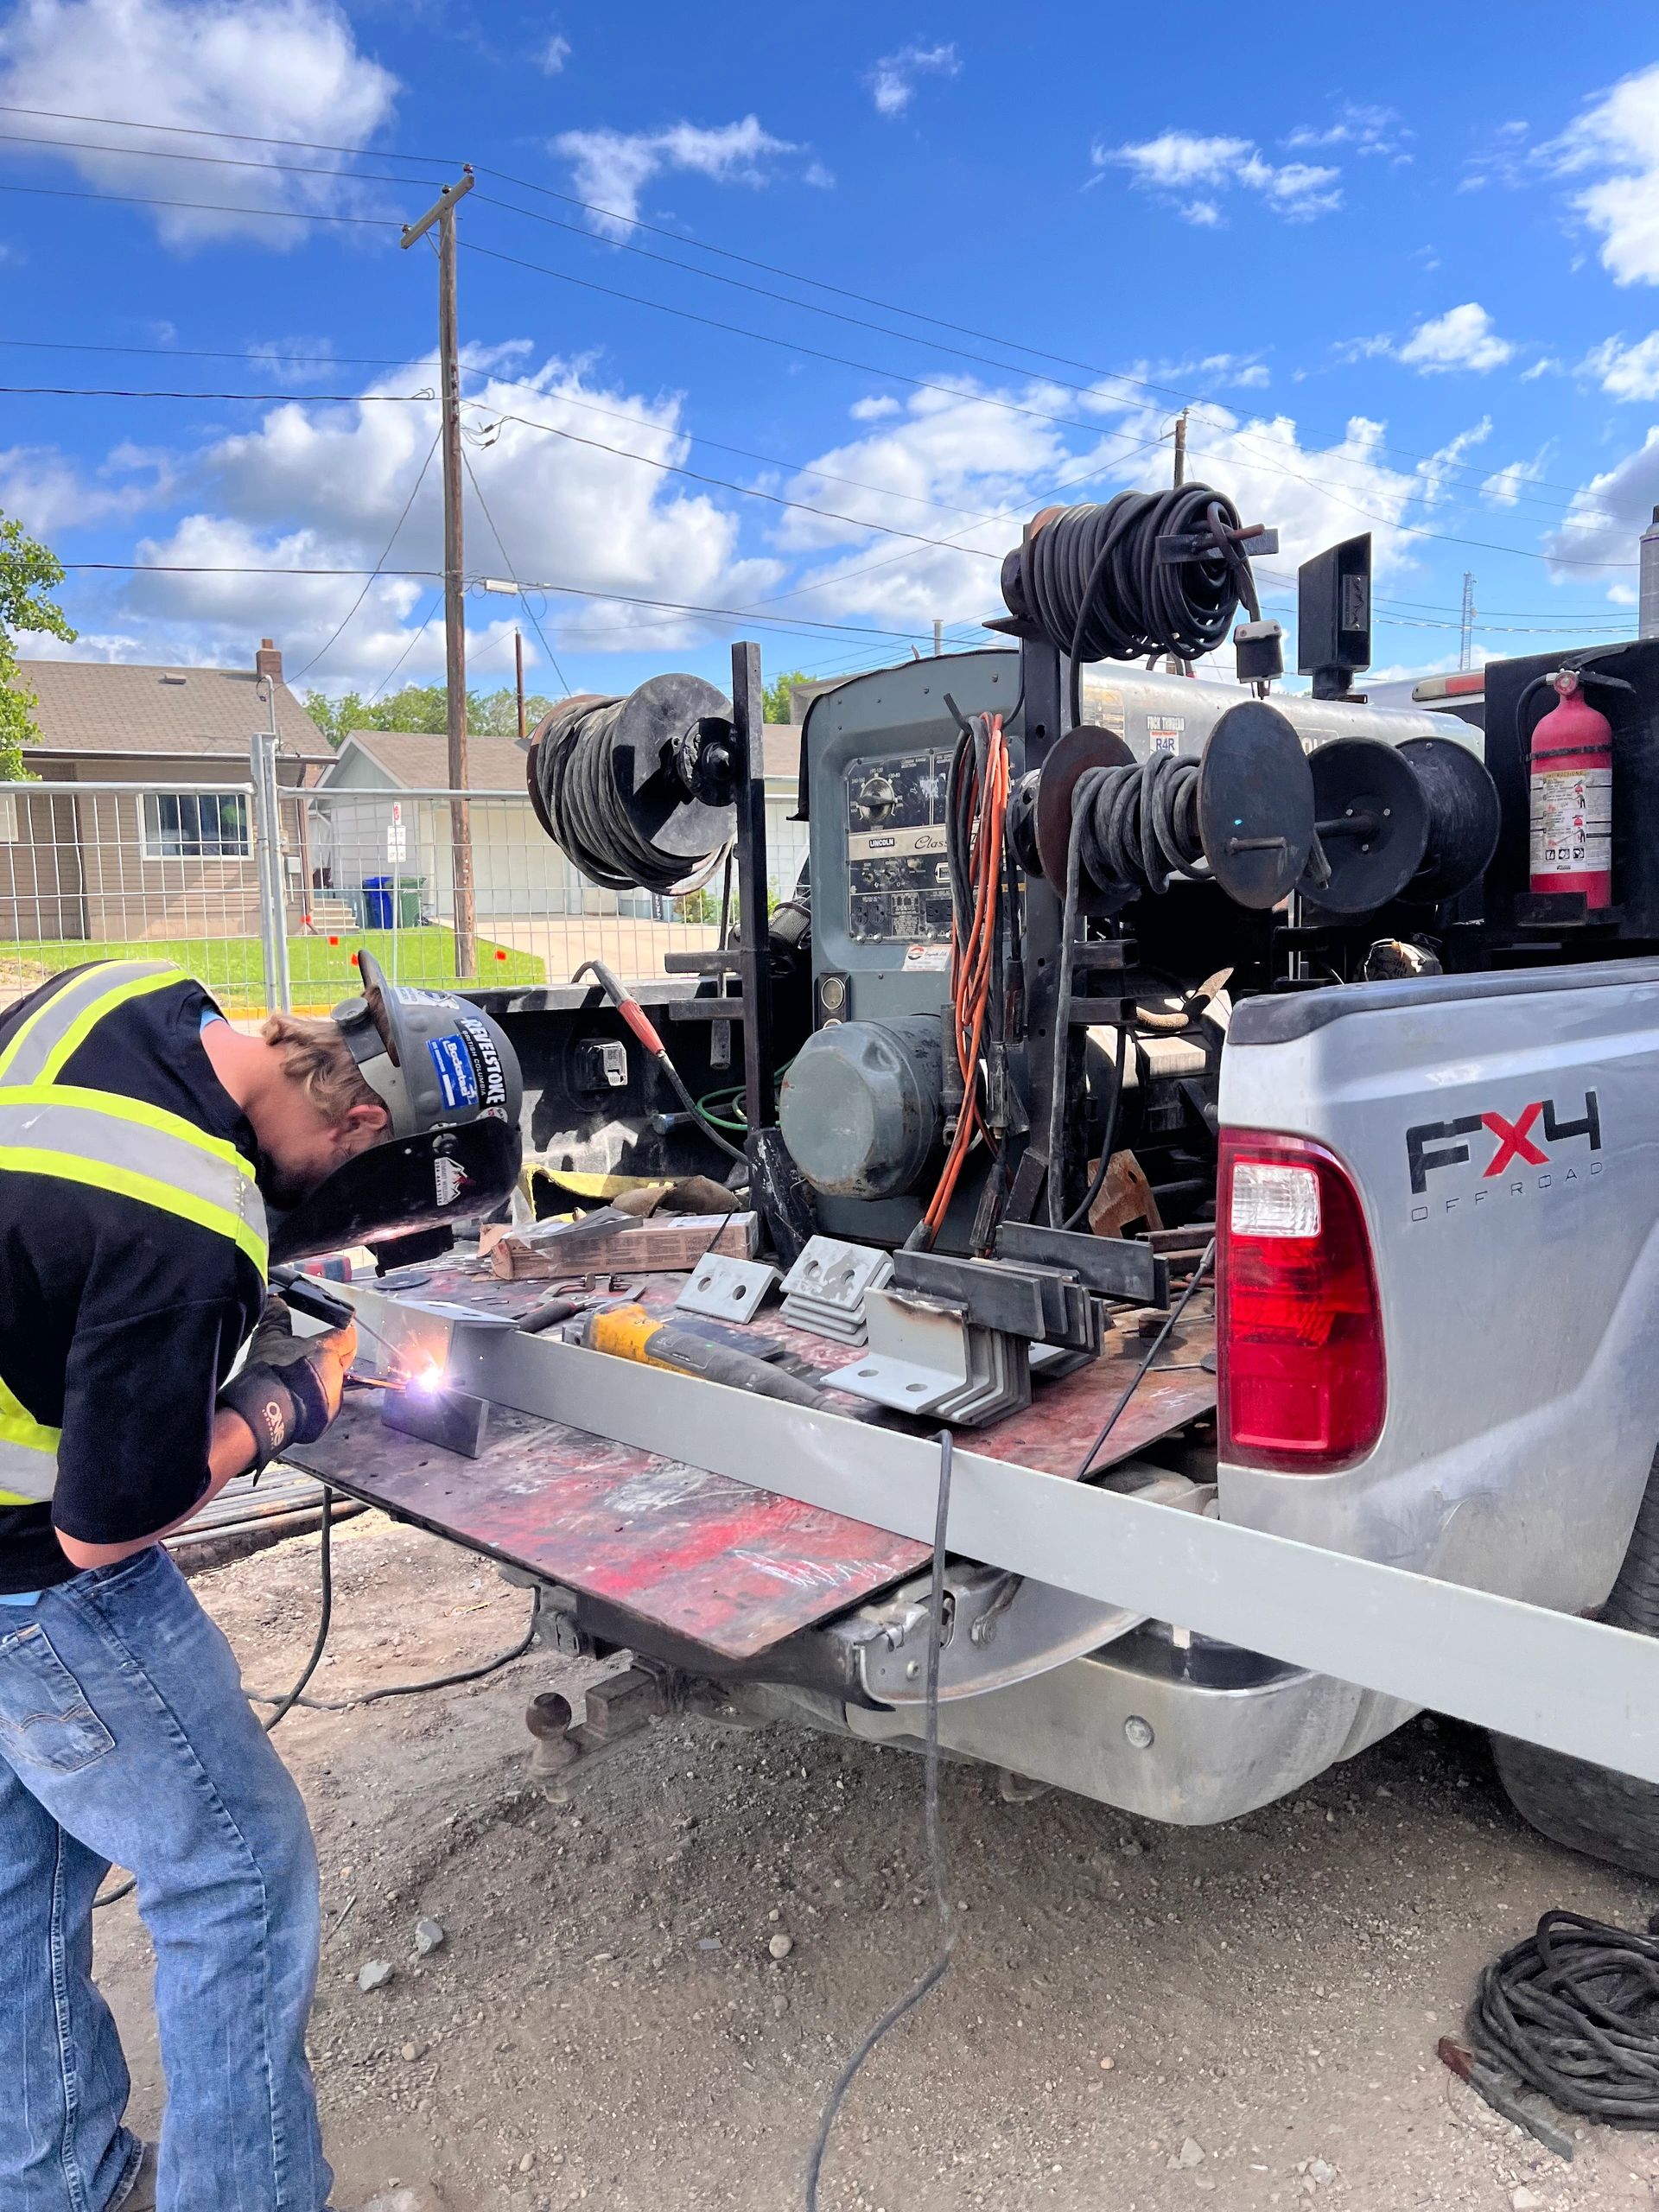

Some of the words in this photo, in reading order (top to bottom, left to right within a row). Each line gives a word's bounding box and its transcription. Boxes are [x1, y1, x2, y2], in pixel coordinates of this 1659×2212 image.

[1155, 738, 1175, 751] R4R
[869, 838, 894, 848] LINCOLN
[461, 1017, 505, 1105] REVELSTOKE
[461, 1030, 478, 1057] BRITISH
[474, 1058, 487, 1096] COLUMBIA
[1406, 1090, 1602, 1195] FX4
